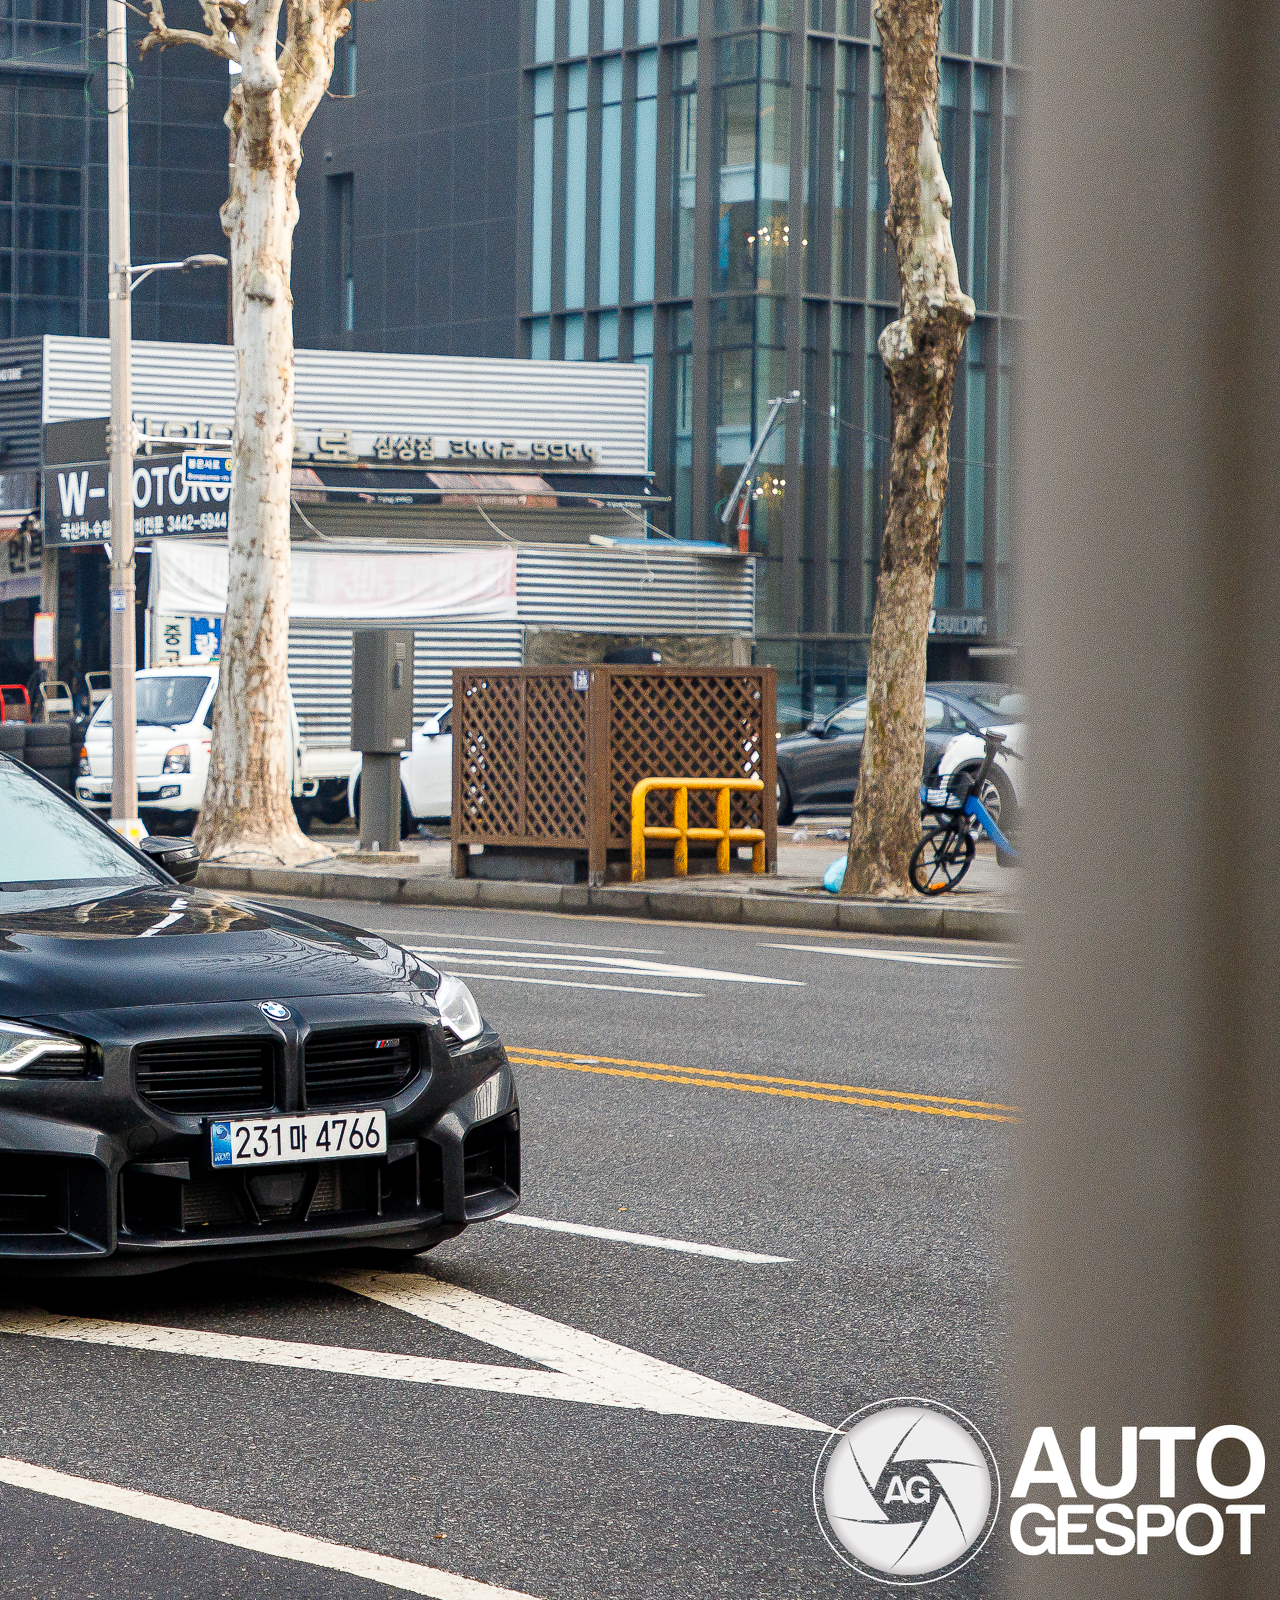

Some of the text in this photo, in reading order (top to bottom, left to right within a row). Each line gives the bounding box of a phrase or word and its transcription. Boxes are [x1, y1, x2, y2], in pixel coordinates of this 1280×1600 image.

[373, 434, 435, 461] 삼성점
[448, 440, 597, 463] 3442-5944
[187, 458, 221, 471] 봉은사로
[57, 463, 230, 518] W-OTO
[167, 512, 227, 532] 3442-5944
[315, 1117, 380, 1152] 4766
